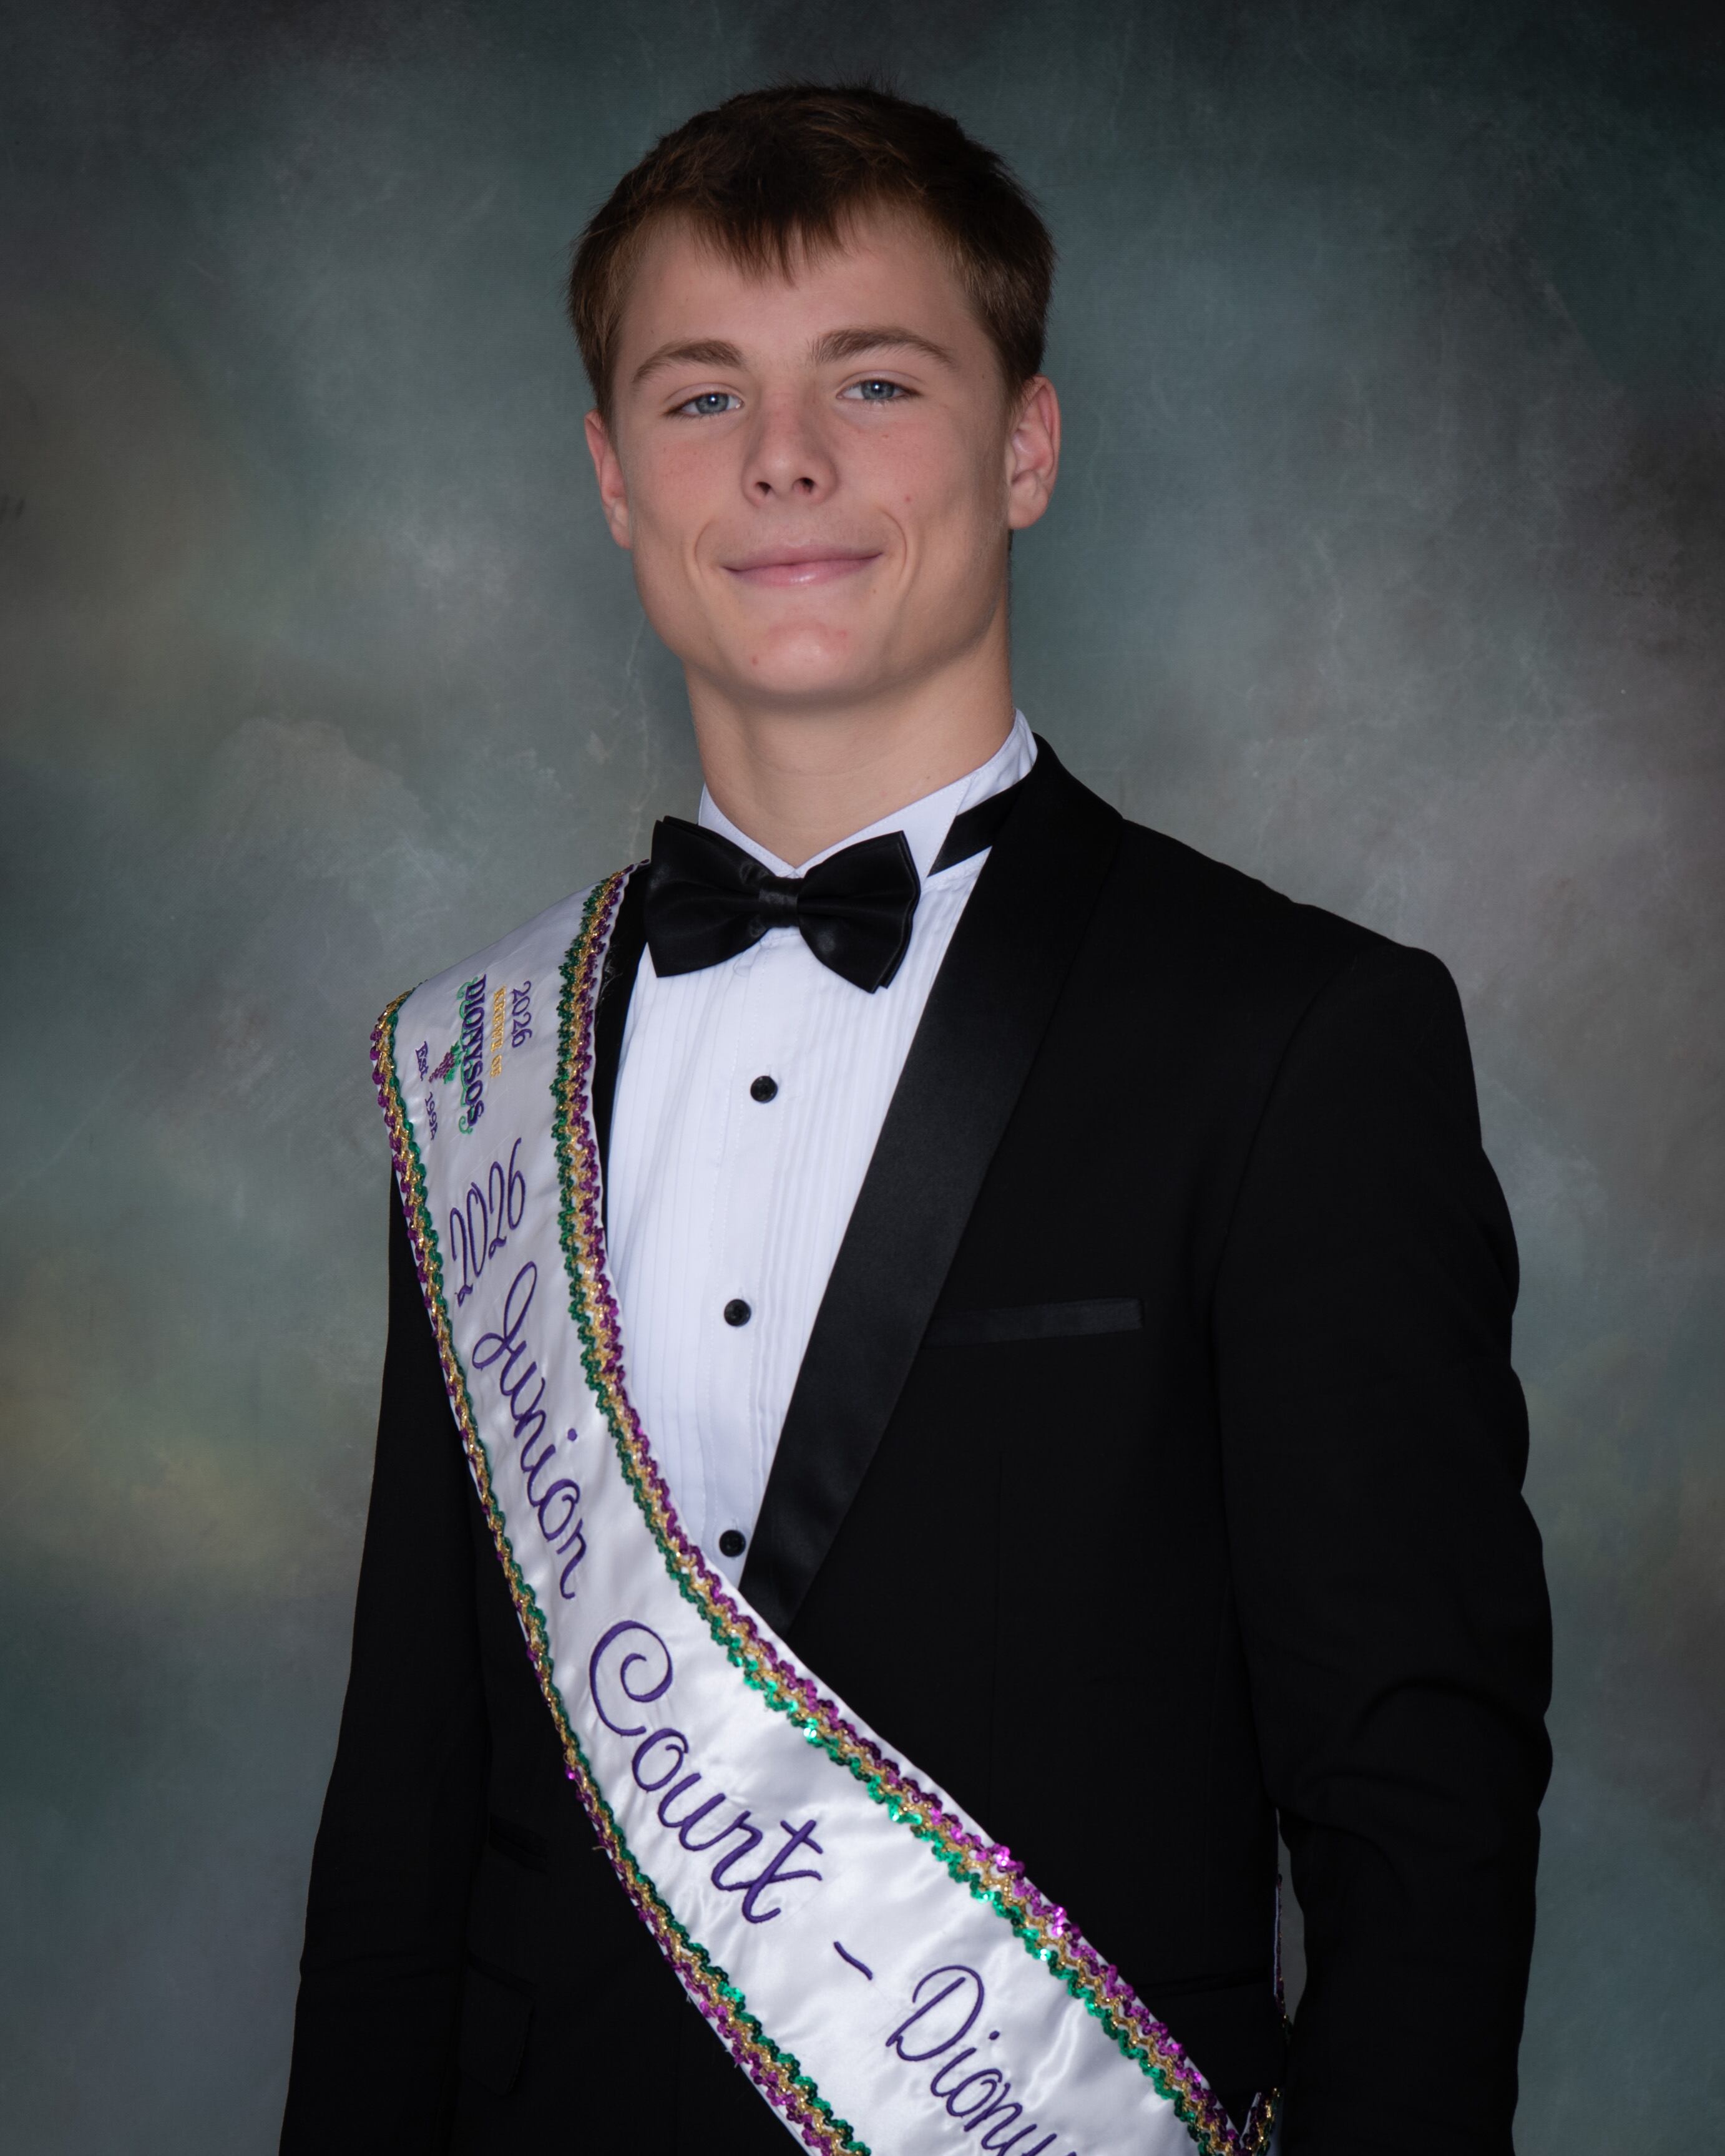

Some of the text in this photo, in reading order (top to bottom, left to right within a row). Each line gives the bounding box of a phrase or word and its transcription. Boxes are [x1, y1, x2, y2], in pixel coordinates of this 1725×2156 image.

[462, 974, 487, 1126] DIONYSOS
[512, 981, 532, 1048] 2026
[449, 1137, 526, 1307] 2026
[472, 1261, 587, 1599] Junior
[589, 1621, 823, 1923] Court
